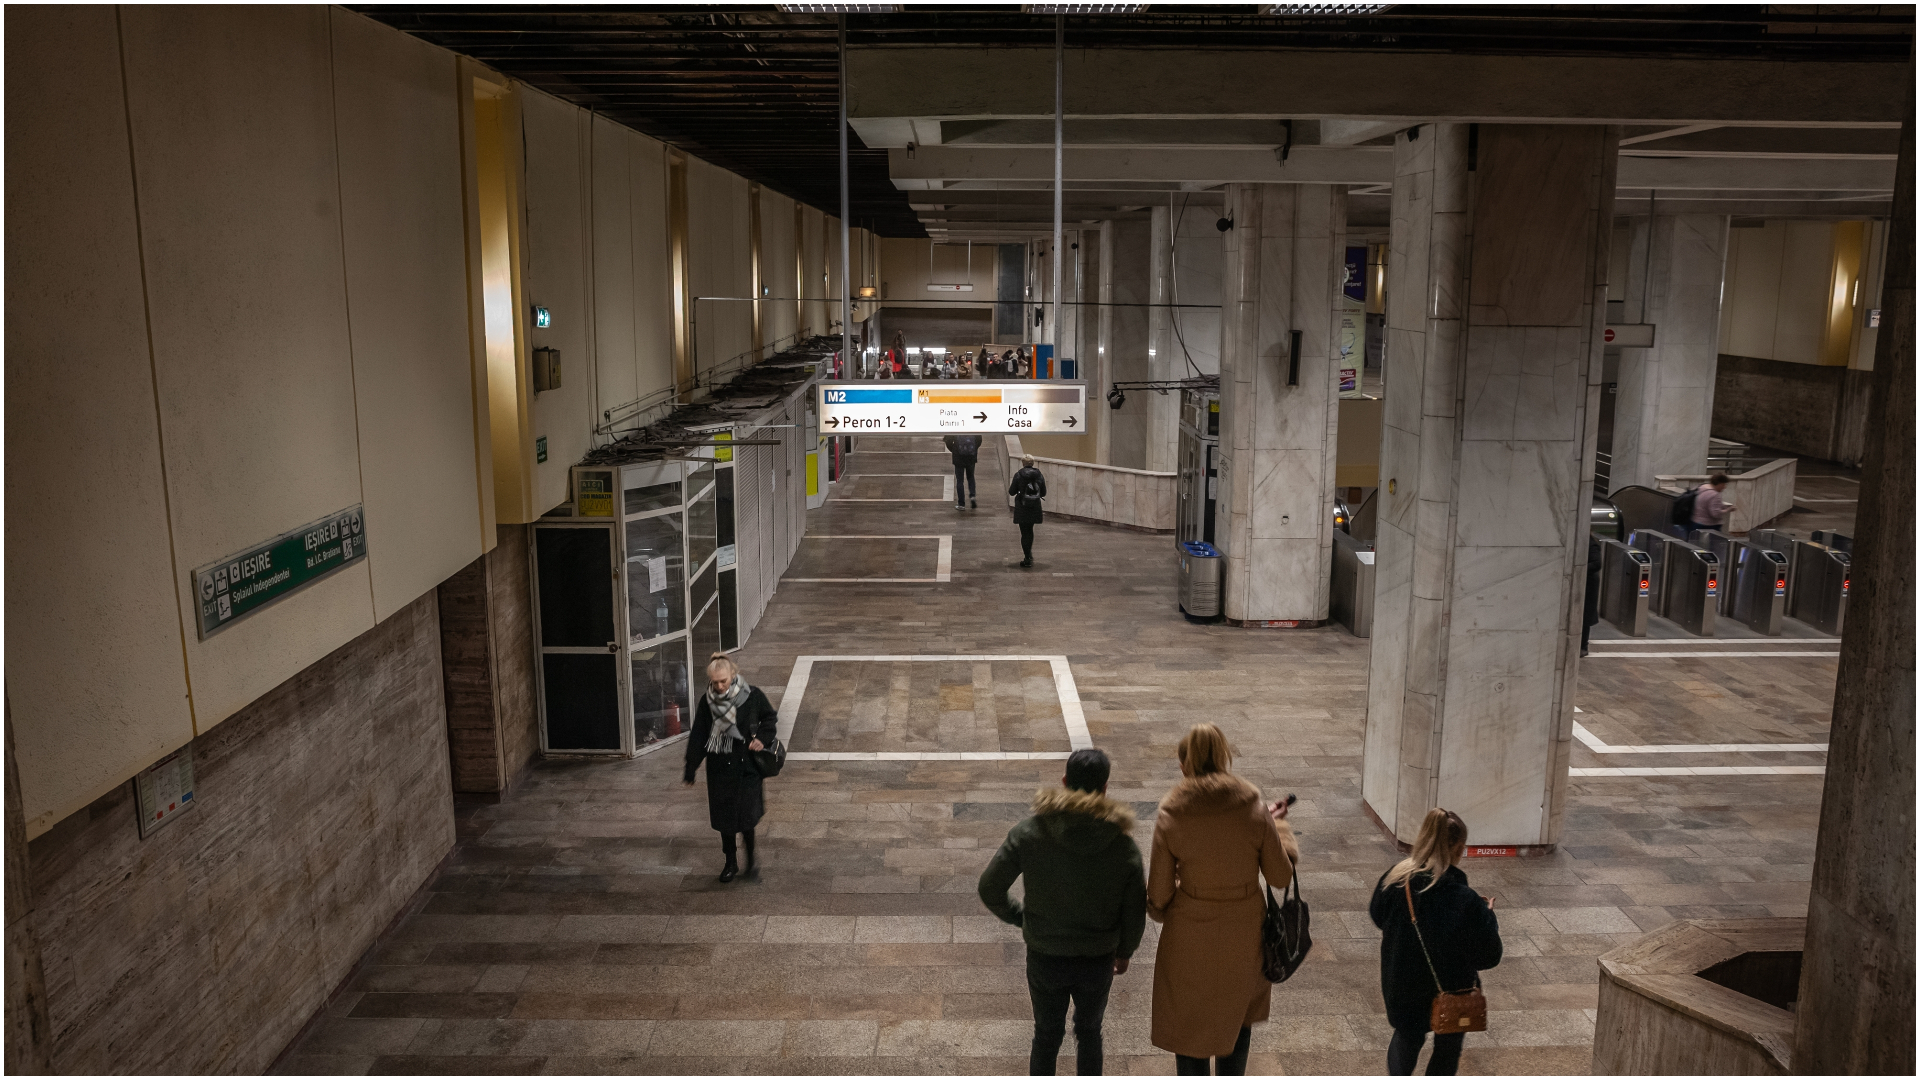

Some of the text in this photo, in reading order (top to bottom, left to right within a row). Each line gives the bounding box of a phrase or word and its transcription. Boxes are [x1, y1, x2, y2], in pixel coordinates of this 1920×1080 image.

[828, 391, 846, 402] M2
[1008, 404, 1028, 415] Info
[843, 415, 906, 428] Peron 1-2
[1007, 417, 1032, 428] Casa
[537, 440, 546, 454] EXIT
[304, 525, 330, 551] IEȘIRE
[352, 534, 363, 547] EXIT
[241, 550, 271, 580] IEȘIRE
[233, 585, 253, 604] Splaiul
[204, 601, 217, 617] EXIT
